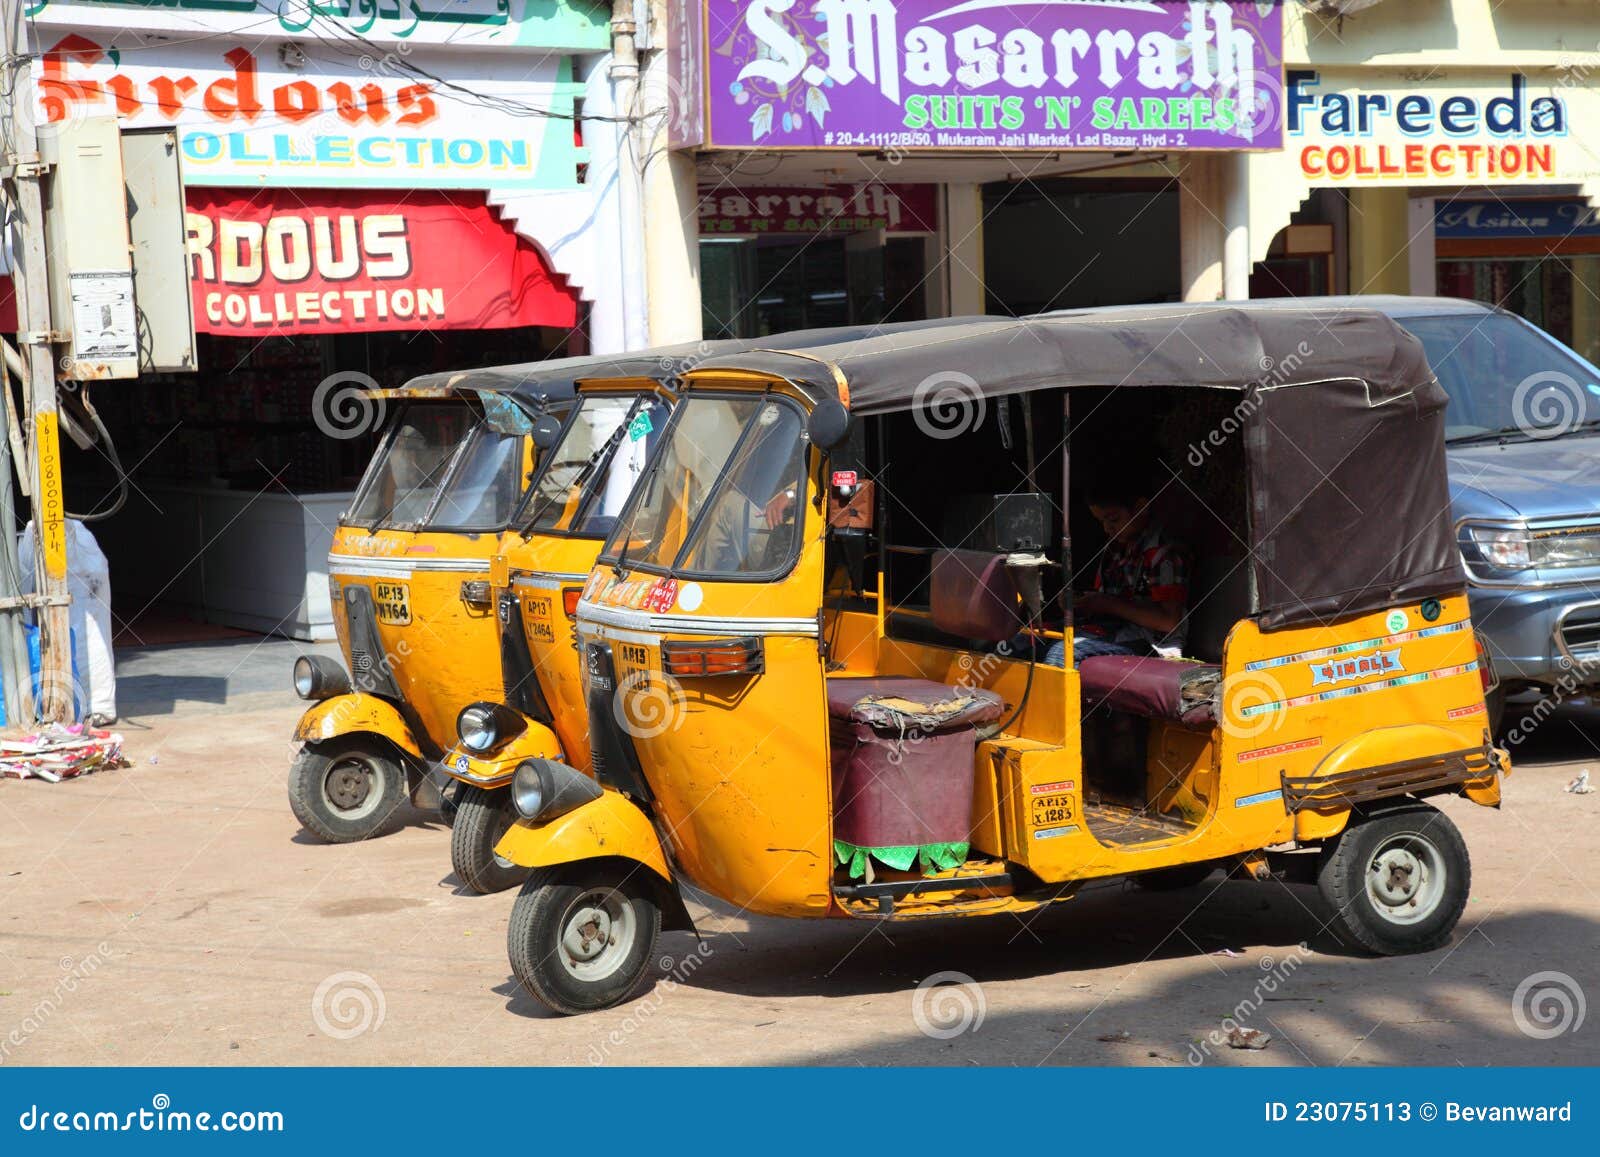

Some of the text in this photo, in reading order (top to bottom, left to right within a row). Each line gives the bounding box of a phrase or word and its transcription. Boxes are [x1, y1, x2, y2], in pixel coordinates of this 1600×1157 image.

[37, 33, 439, 128] Firdous
[902, 94, 1025, 130] SUITS
[1091, 96, 1237, 131] SAREES
[1286, 70, 1567, 136] Fareeda
[181, 131, 531, 168] OLLECTION
[938, 133, 996, 146] Mukaram
[999, 133, 1025, 146] Jahi
[1077, 133, 1099, 146] Lad
[1142, 133, 1167, 147] Hyd
[1300, 144, 1556, 180] COLLECTION
[698, 184, 902, 227] sarrath
[1437, 204, 1549, 228] Asian
[187, 214, 411, 286] RDOUS
[206, 288, 446, 326] COLLECTION
